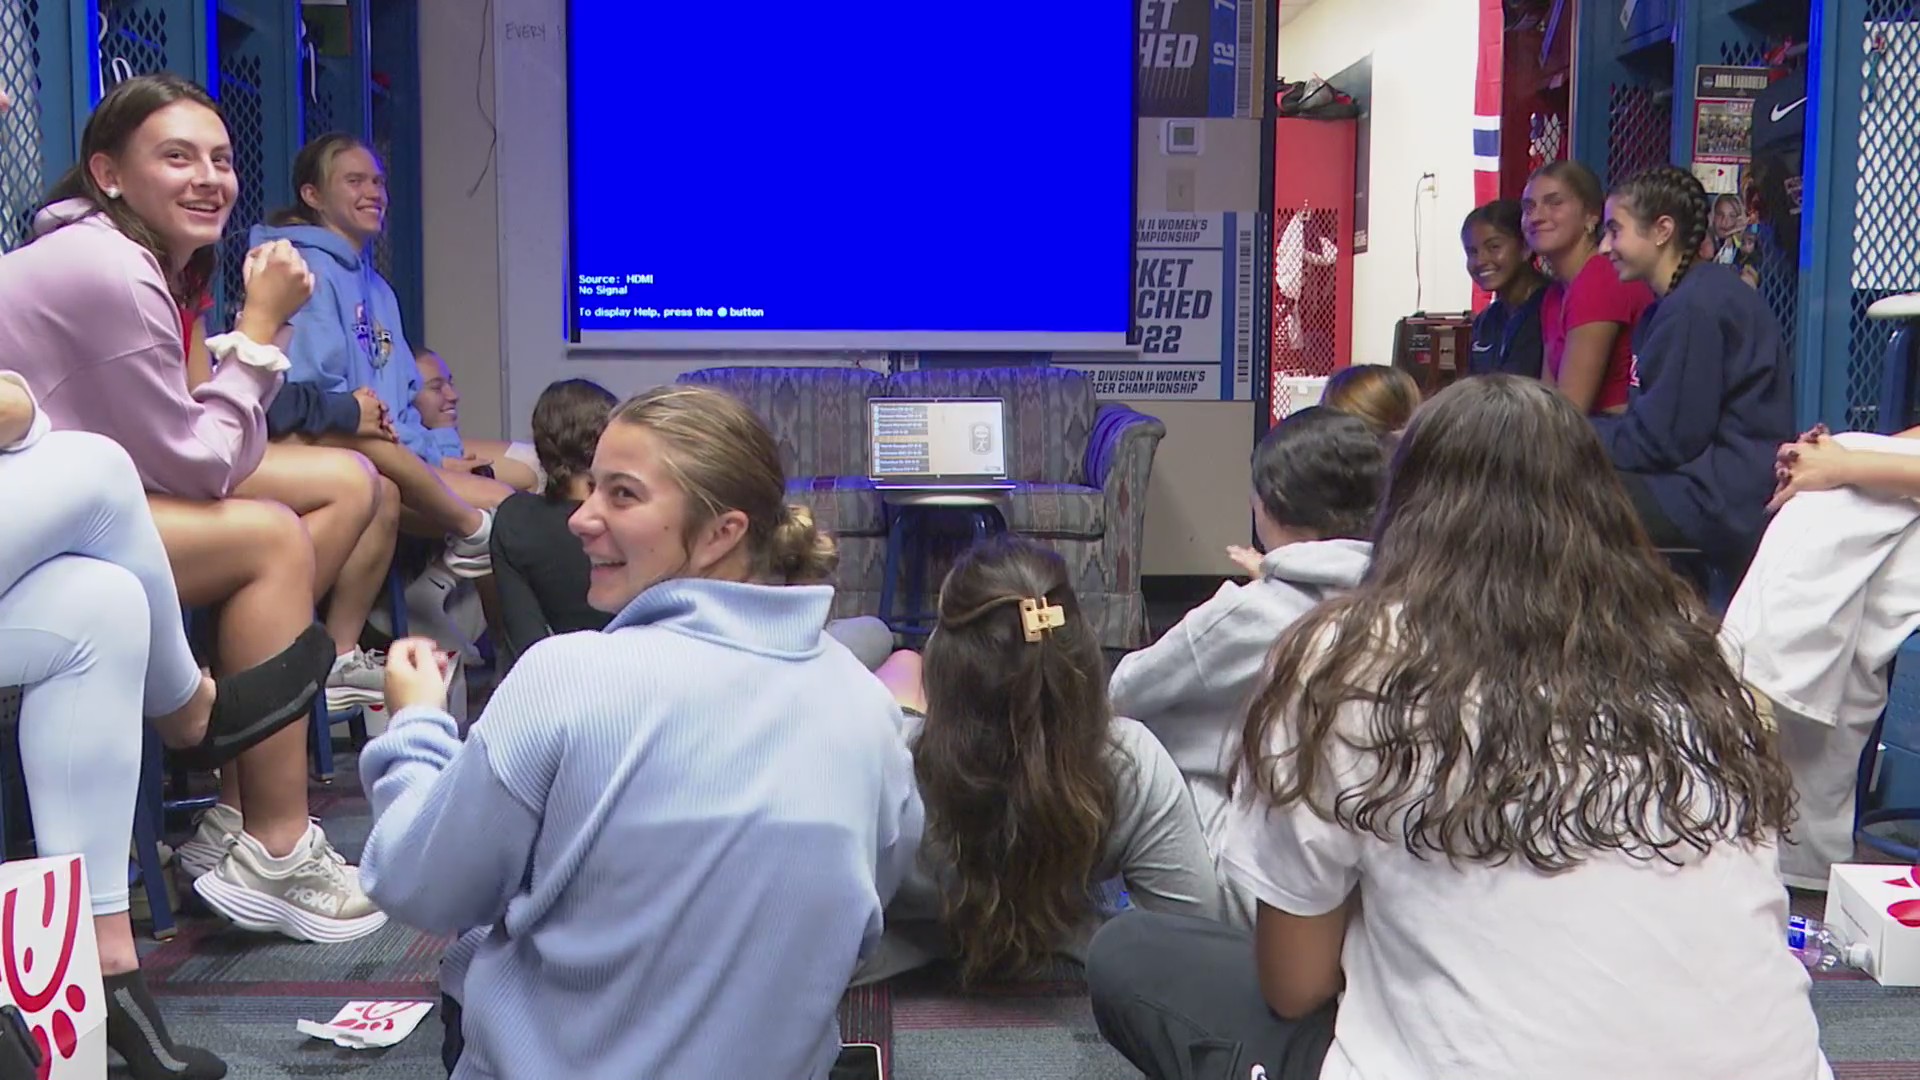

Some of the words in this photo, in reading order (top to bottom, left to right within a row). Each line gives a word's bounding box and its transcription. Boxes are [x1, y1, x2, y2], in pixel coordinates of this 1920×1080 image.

[1140, 0, 1179, 30] ET
[505, 22, 546, 42] EVERY
[1213, 42, 1235, 66] 12
[1158, 219, 1208, 231] WOMEN'S
[578, 274, 620, 284] Source:
[626, 274, 653, 284] HDMI
[1137, 258, 1194, 288] KET
[578, 286, 593, 295] No
[596, 285, 628, 296] Signal
[1136, 289, 1213, 319] CHED
[579, 307, 591, 317] To
[594, 307, 631, 318] display
[633, 307, 661, 318] Help,
[663, 309, 692, 318] press
[696, 307, 713, 317] the
[729, 307, 764, 317] button
[1098, 370, 1144, 382] DIVISION
[1145, 370, 1153, 382] II
[1155, 370, 1206, 382] WOMEN'S
[1092, 382, 1116, 394] CER
[1118, 382, 1198, 394] CHAMPIONSHIP
[284, 884, 337, 917] HOKA
